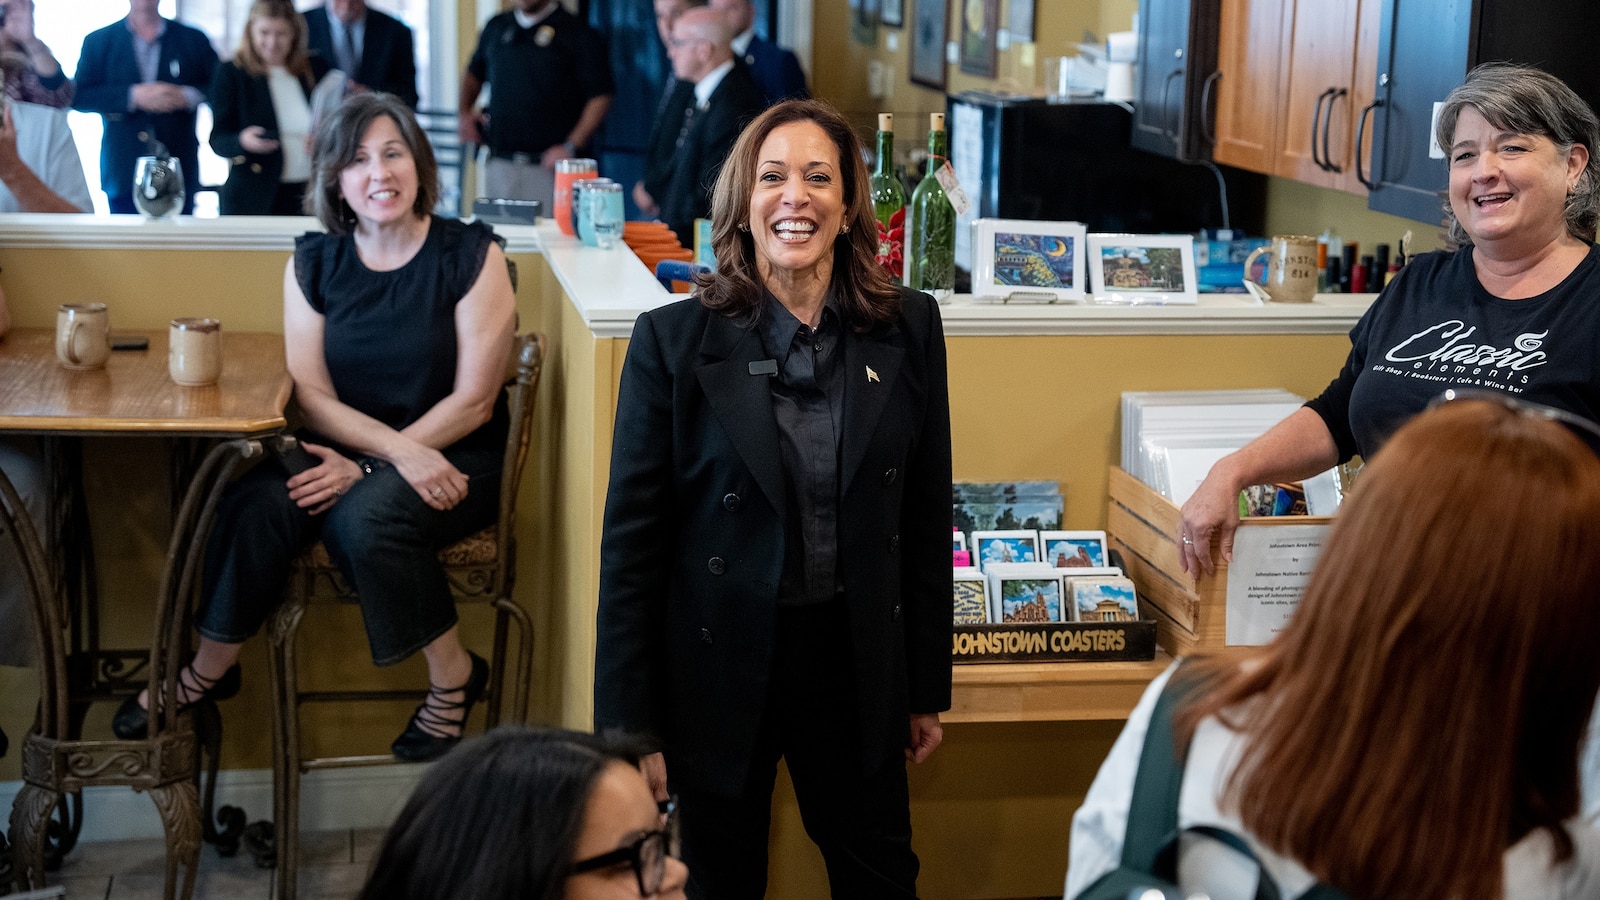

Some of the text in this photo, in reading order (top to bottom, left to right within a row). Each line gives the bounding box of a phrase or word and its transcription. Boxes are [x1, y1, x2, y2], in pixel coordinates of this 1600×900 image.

[1292, 269, 1309, 278] 614
[1385, 319, 1548, 371] Classic
[1372, 364, 1385, 372] Gift
[1385, 366, 1403, 376] Shop
[1411, 372, 1447, 382] Bookstore
[1484, 380, 1505, 390] Wine
[1508, 384, 1524, 393] Bar
[1413, 360, 1529, 384] elements
[952, 629, 1125, 655] JOHNSTOWN COASTERS
